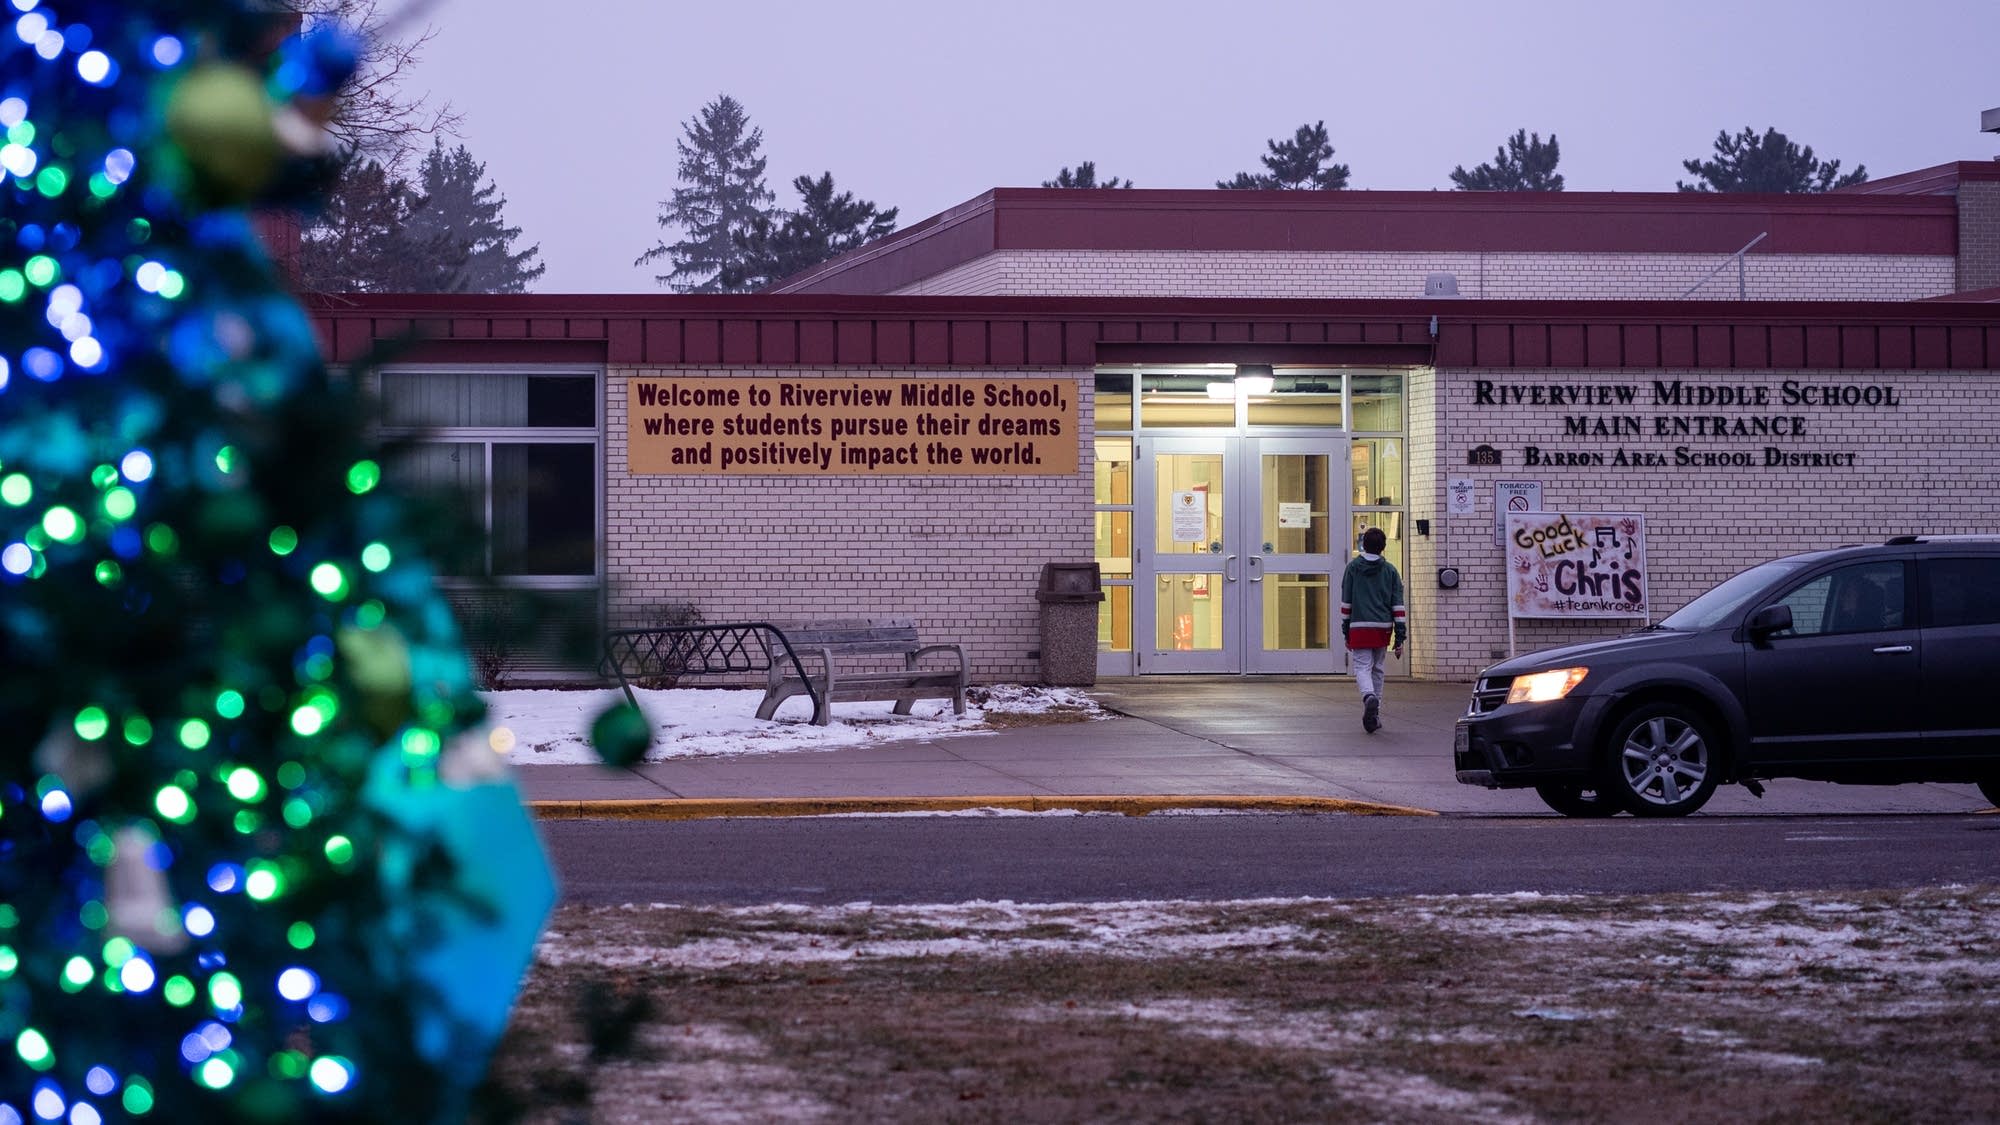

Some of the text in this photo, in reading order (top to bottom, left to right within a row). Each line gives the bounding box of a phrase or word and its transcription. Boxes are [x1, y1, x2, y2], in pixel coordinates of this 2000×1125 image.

[637, 383, 1066, 412] Welcome to Riverview Middle School,
[1473, 380, 1900, 406] RIVERVIEW MIDDLE SCHOOL
[644, 413, 1061, 441] where students pursue their dreams
[1563, 416, 1806, 436] MAIN ENTRANCE
[671, 442, 1041, 470] and positively impact the world.
[1476, 451, 1494, 464] 135
[1524, 446, 1856, 467] BARRON AREA SCHOOL DISTRICT
[1515, 514, 1574, 548] Good
[1540, 529, 1588, 558] Luck
[1555, 560, 1642, 603] Chris
